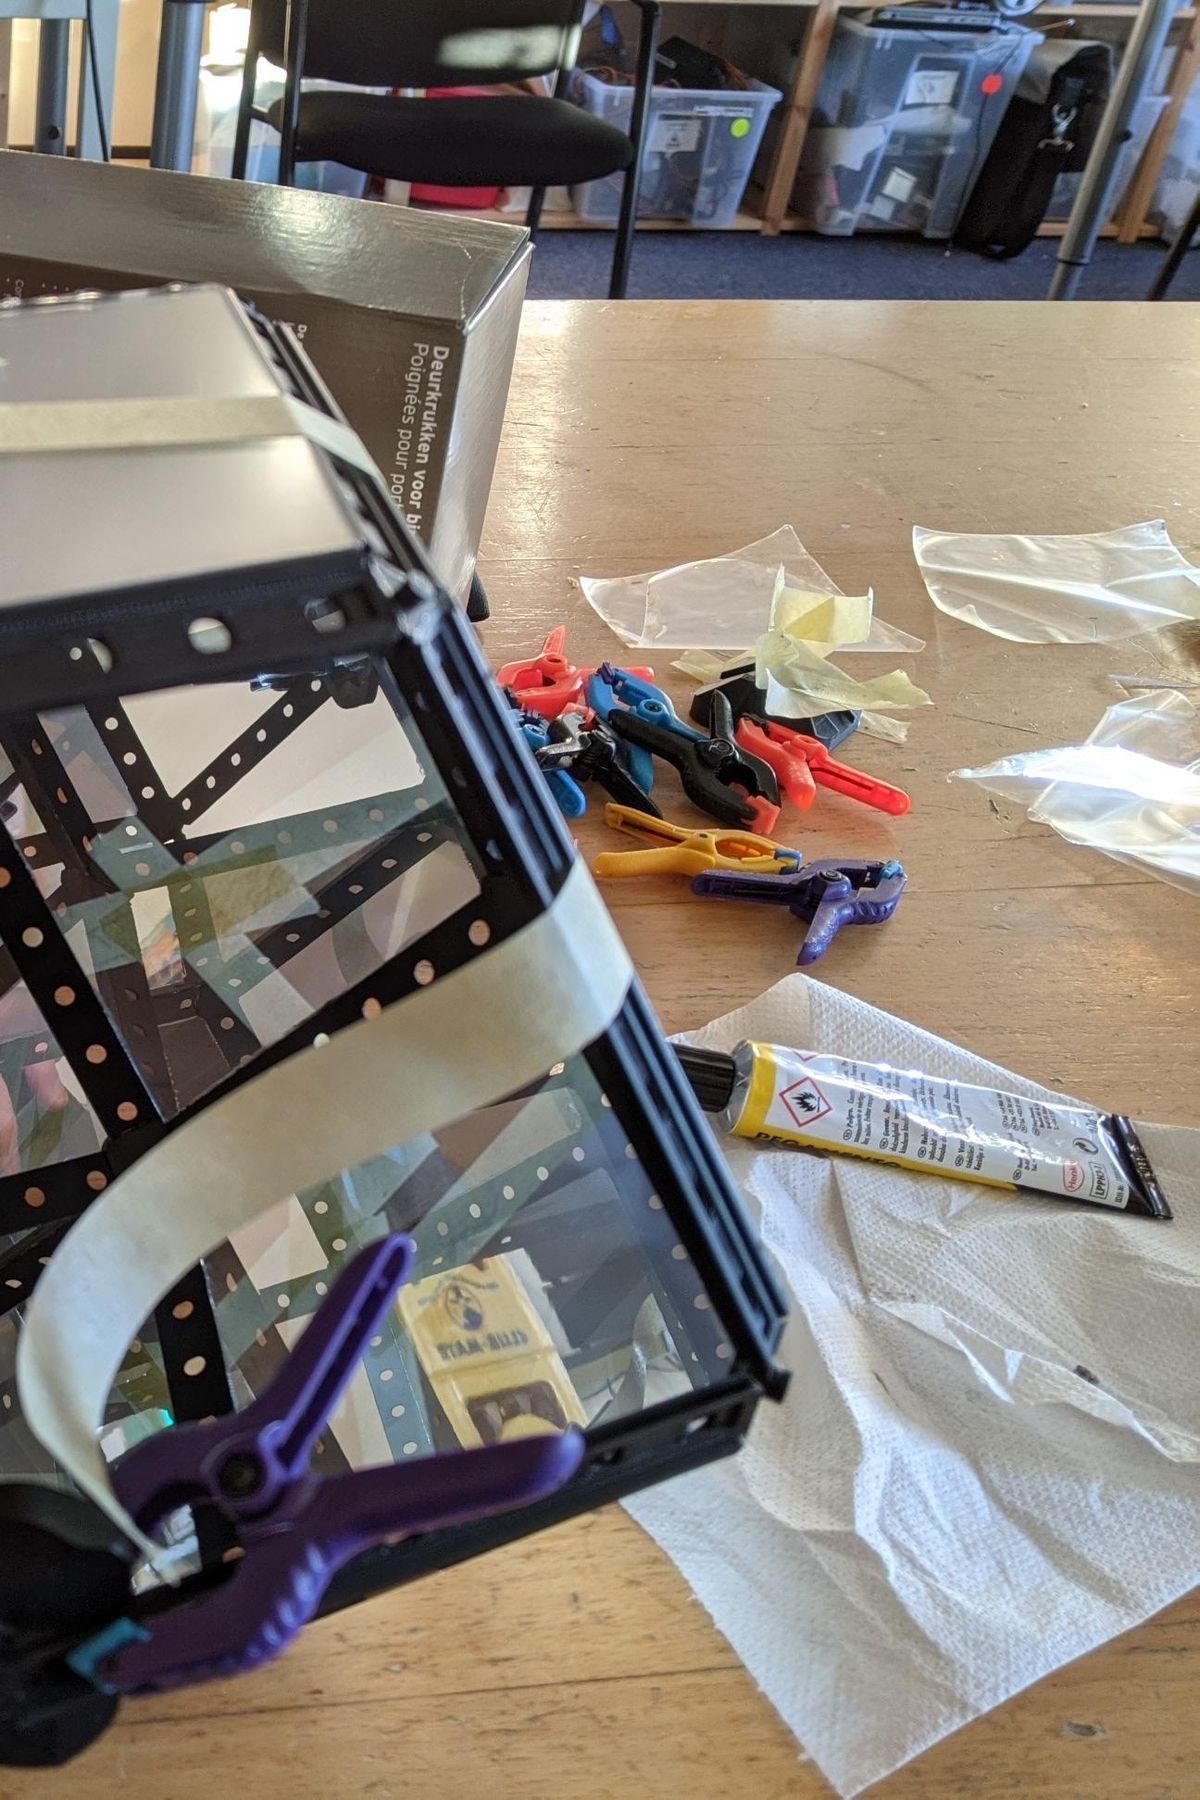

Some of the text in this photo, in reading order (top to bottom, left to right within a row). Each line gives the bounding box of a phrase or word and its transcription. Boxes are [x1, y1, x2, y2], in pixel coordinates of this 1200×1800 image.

[403, 343, 429, 425] Poignées
[415, 345, 450, 464] Deurkrukken
[395, 428, 413, 470] pour
[410, 469, 427, 509] voor
[1067, 1160, 1079, 1189] Henk
